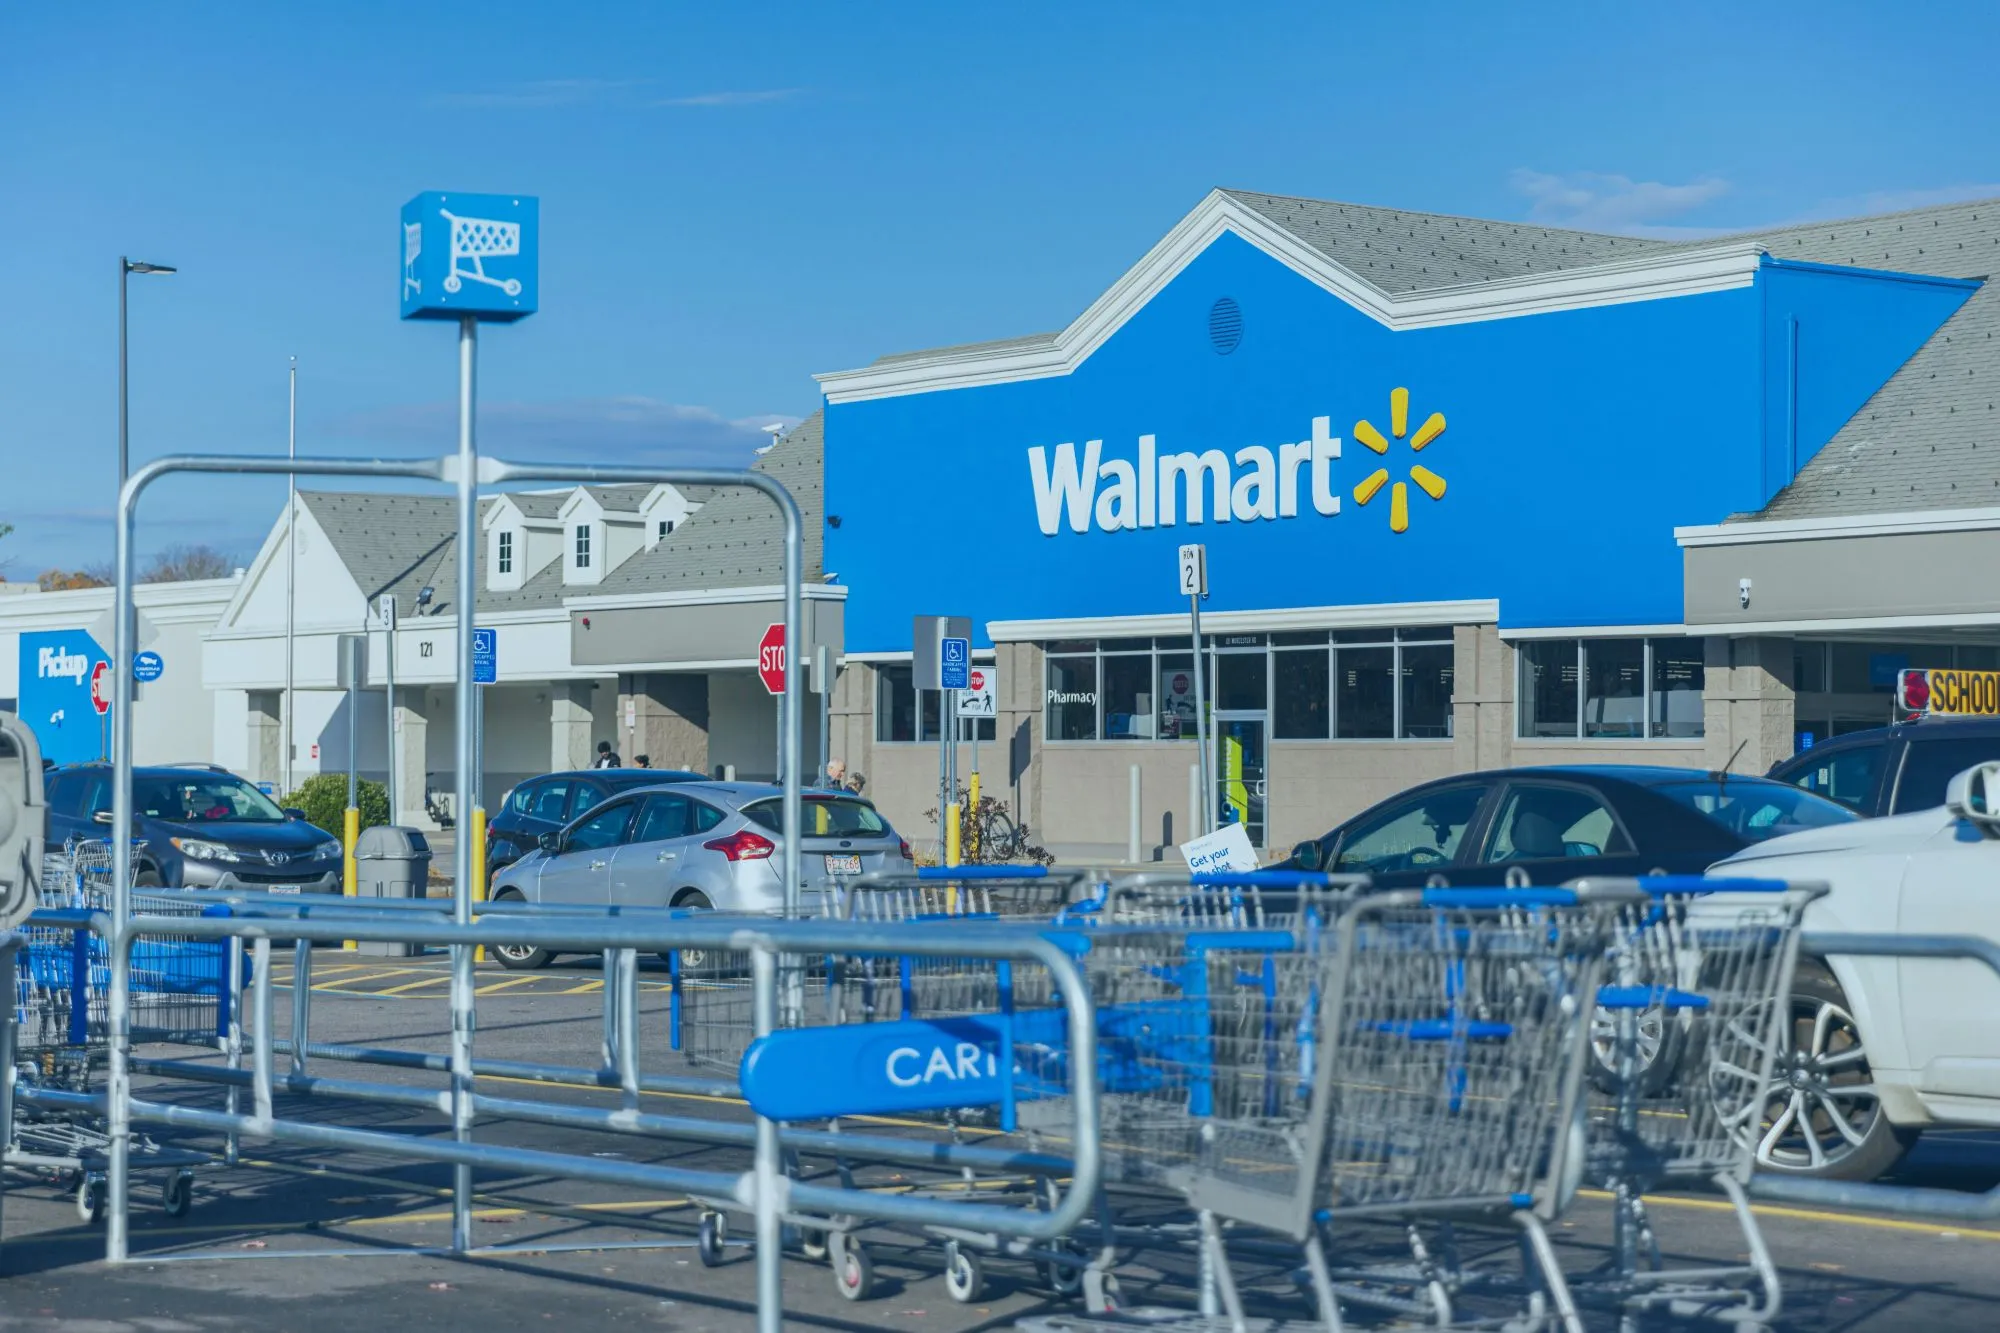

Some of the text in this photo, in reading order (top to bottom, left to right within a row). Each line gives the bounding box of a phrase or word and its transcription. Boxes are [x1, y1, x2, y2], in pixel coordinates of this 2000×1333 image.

[1028, 415, 1341, 536] Walmart
[1185, 564, 1194, 588] 2
[383, 608, 390, 626] 3
[419, 641, 434, 658] 121
[762, 646, 785, 671] STO
[38, 646, 88, 686] Pickup
[1048, 689, 1097, 706] Pharmacy
[1190, 848, 1229, 868] Get your
[1211, 861, 1232, 876] shot
